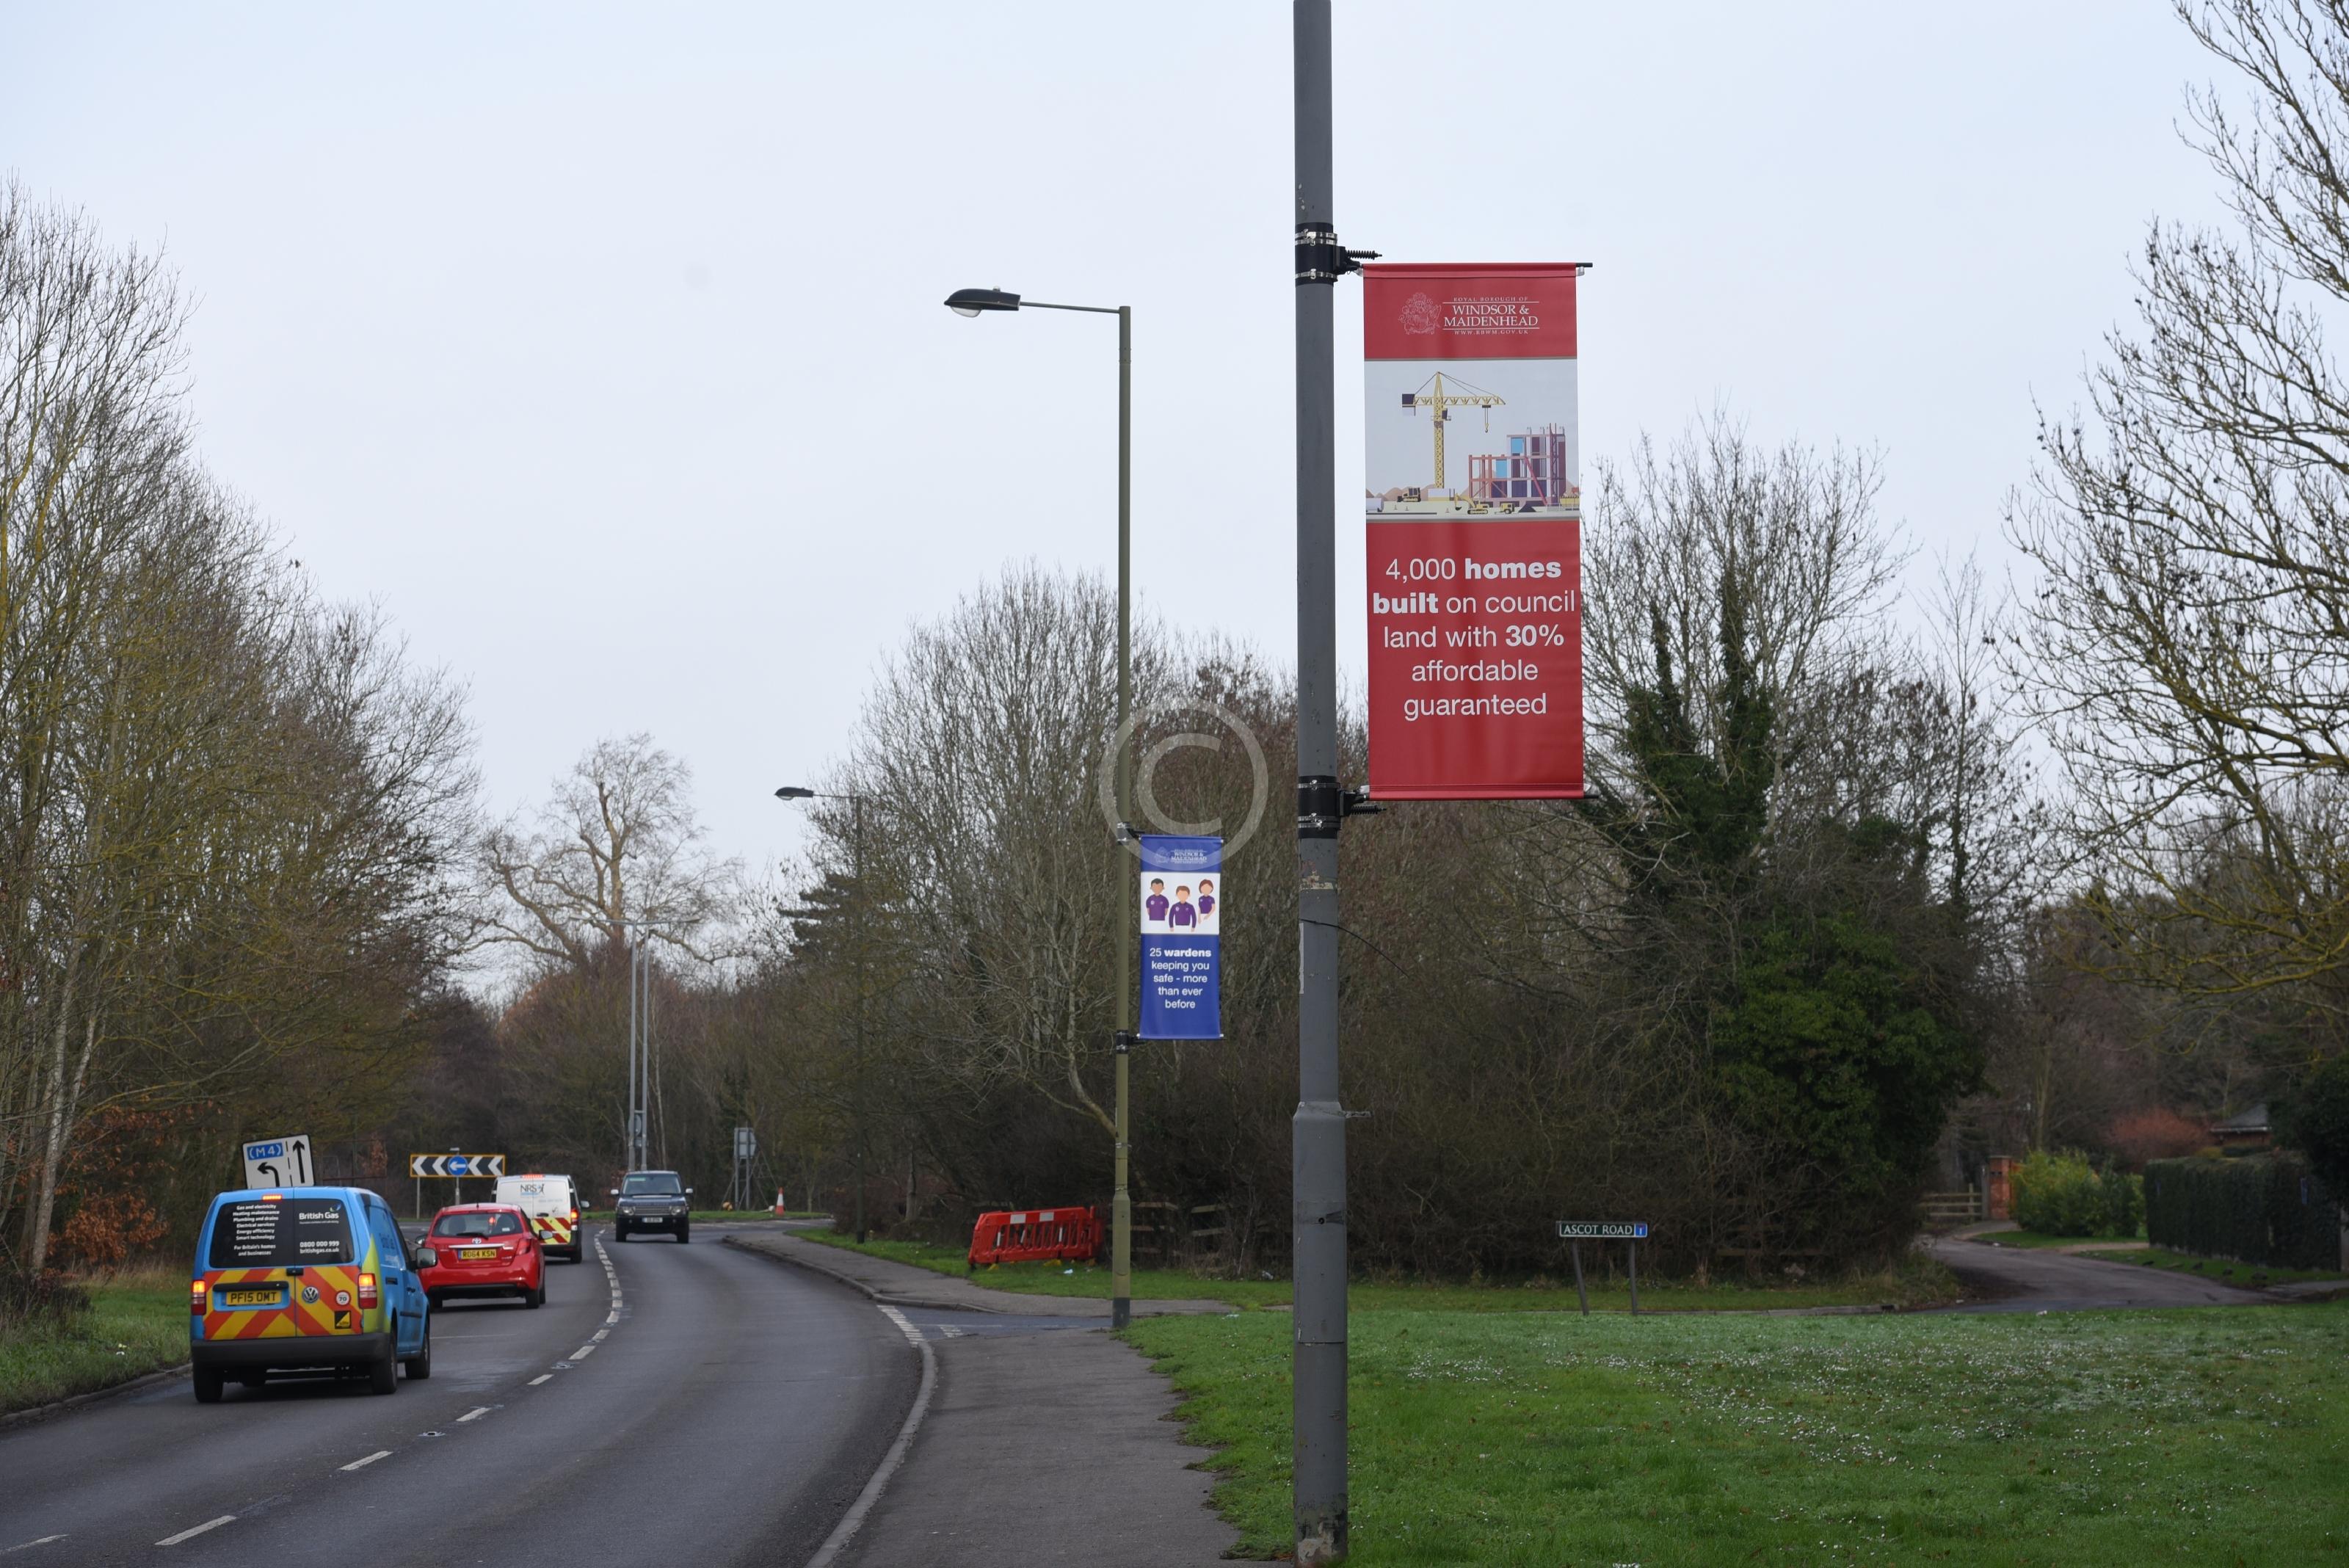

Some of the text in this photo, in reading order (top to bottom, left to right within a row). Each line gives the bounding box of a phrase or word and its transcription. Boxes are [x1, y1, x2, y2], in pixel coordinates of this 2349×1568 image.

[1452, 305, 1530, 315] WINDSOR &
[1444, 316, 1539, 327] MAIDENHEAD
[1385, 558, 1562, 584] 4,000 homes
[1373, 589, 1575, 614] built on council
[1384, 624, 1564, 647] land with 30%
[1411, 659, 1539, 681] affordable
[1404, 692, 1547, 722] guaranteed
[1150, 948, 1212, 957] 25 wardens
[1151, 960, 1210, 973] keeping you
[1153, 973, 1174, 983] safe
[1183, 975, 1208, 983] more
[1158, 986, 1203, 996] than ever
[1165, 999, 1196, 1009] before
[520, 1183, 537, 1193] NRS
[1564, 1224, 1633, 1235] ASCOT ROAD
[230, 1292, 254, 1303] PF15
